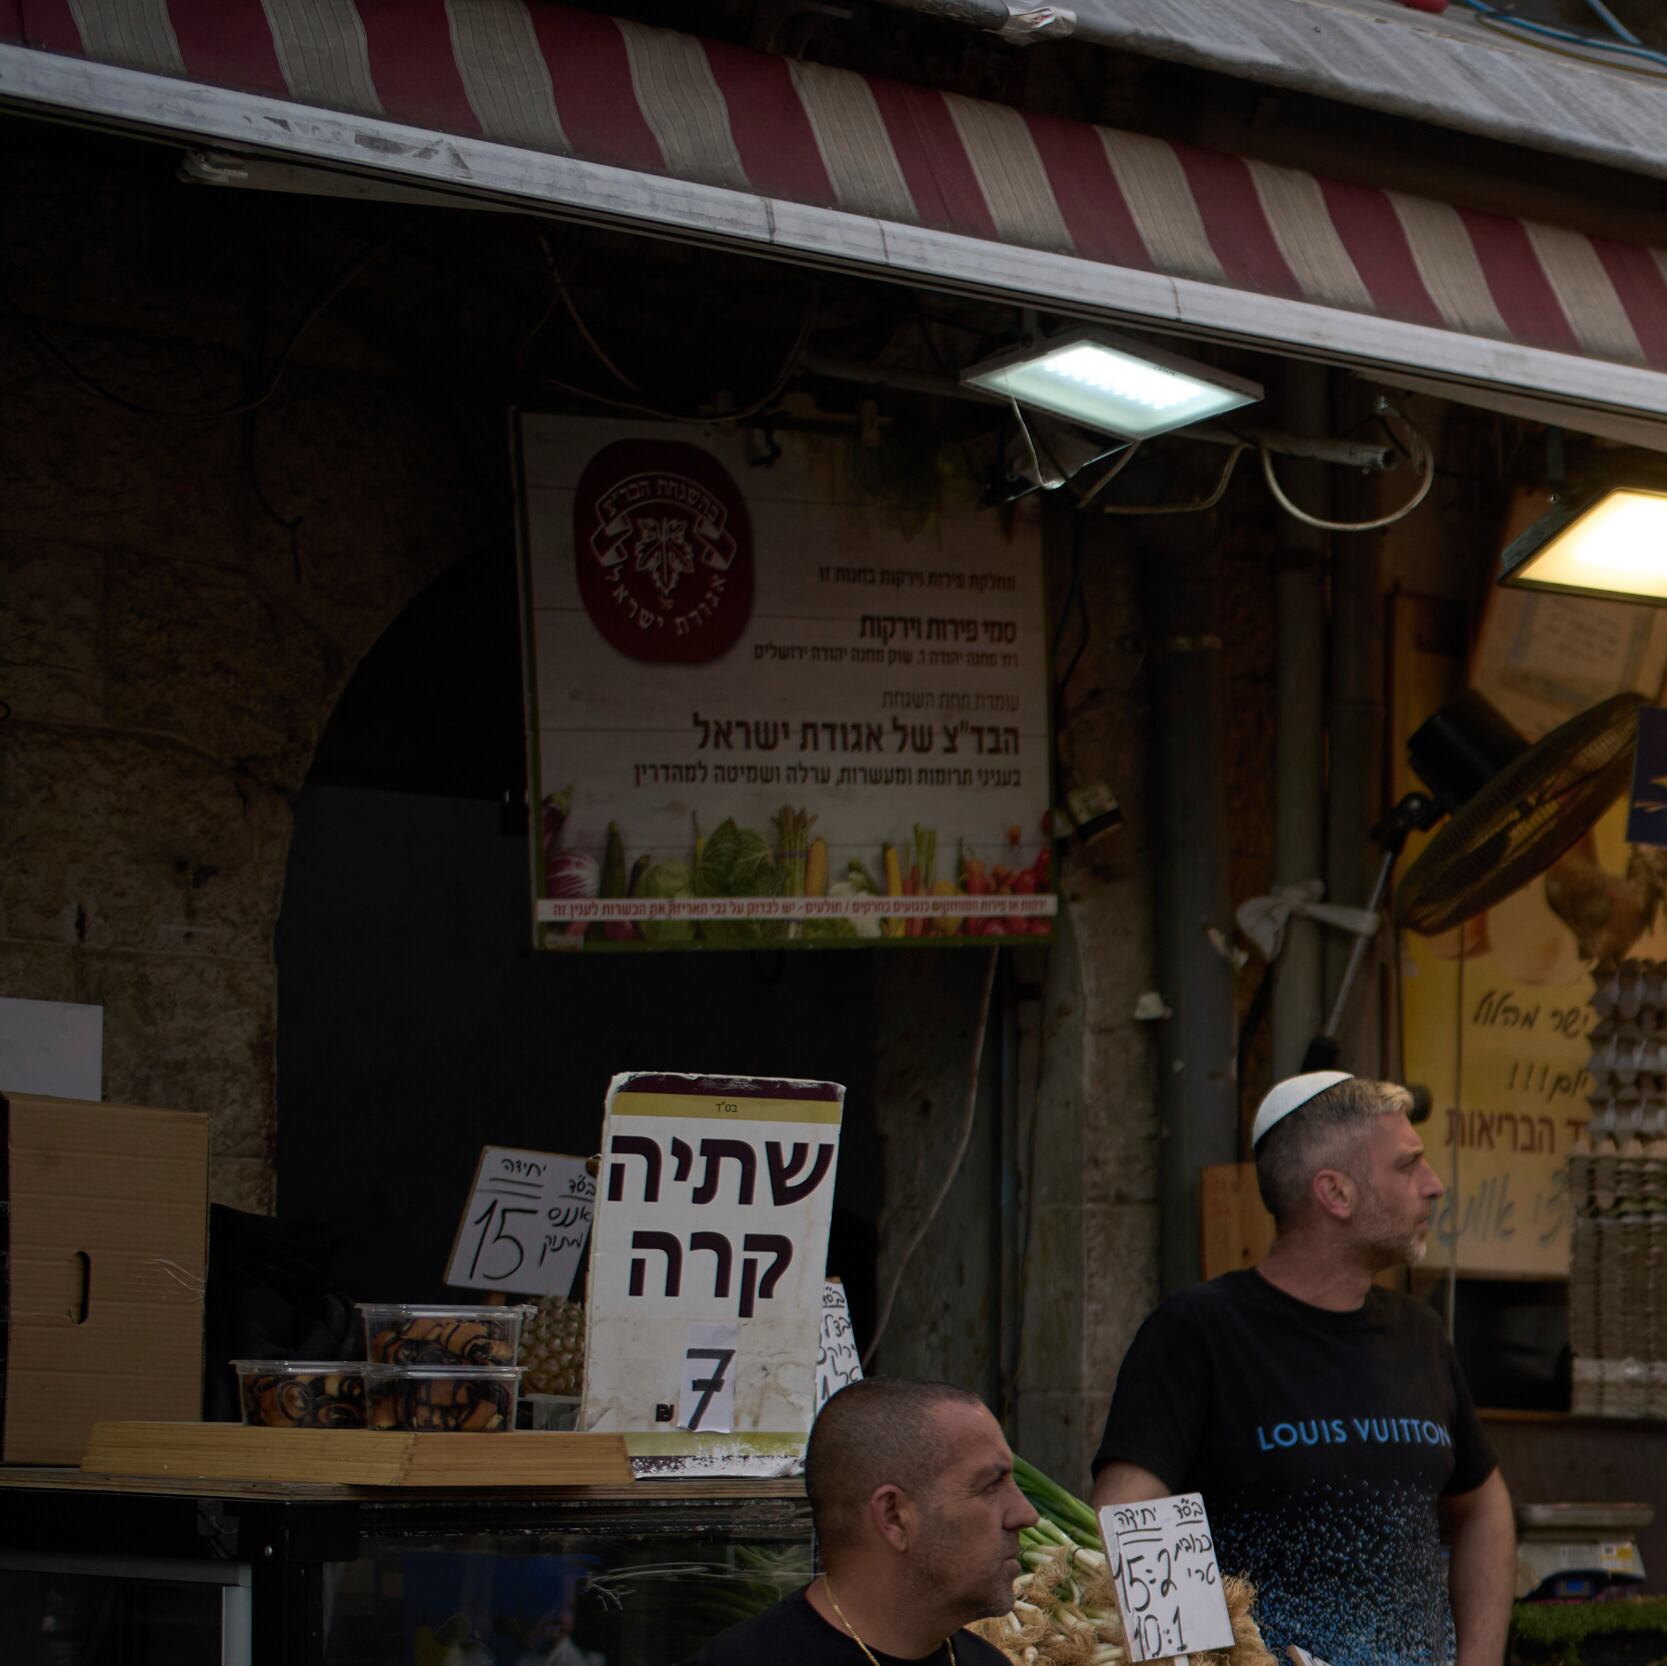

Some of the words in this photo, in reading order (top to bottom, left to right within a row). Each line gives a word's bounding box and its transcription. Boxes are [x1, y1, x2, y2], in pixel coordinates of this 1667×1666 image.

[927, 570, 965, 589] פירות
[859, 613, 922, 646] וירקות
[925, 617, 979, 643] פירות
[981, 619, 1017, 644] סמי
[753, 640, 808, 661] ירושלים
[811, 645, 848, 662] יהודה
[850, 647, 885, 664] מחנה
[887, 648, 914, 667] שוק
[929, 650, 964, 666] יהודה
[691, 710, 791, 752] ישראל
[799, 718, 885, 753] אגודת
[891, 715, 934, 754] של
[942, 718, 1020, 756] הבד"צ
[633, 760, 708, 788] למהדרין
[713, 763, 781, 784] ושמיטה
[785, 762, 832, 784] ערלה
[916, 766, 974, 787] תרומות
[1472, 988, 1541, 1031] מהלול
[1548, 1007, 1590, 1041] ישר
[715, 1102, 738, 1113] בס"ד
[1443, 1105, 1556, 1154] הבריאות
[501, 1157, 548, 1178] יחידה
[607, 1134, 836, 1207] שתיה
[548, 1205, 592, 1228] אננס
[469, 1197, 539, 1281] 15
[538, 1233, 584, 1268] מתוק
[628, 1229, 795, 1320] קרה
[686, 1348, 737, 1433] 7
[1256, 1418, 1349, 1452] LOUIS
[1351, 1415, 1454, 1449] VUITTON
[1114, 1506, 1157, 1531] יחידה
